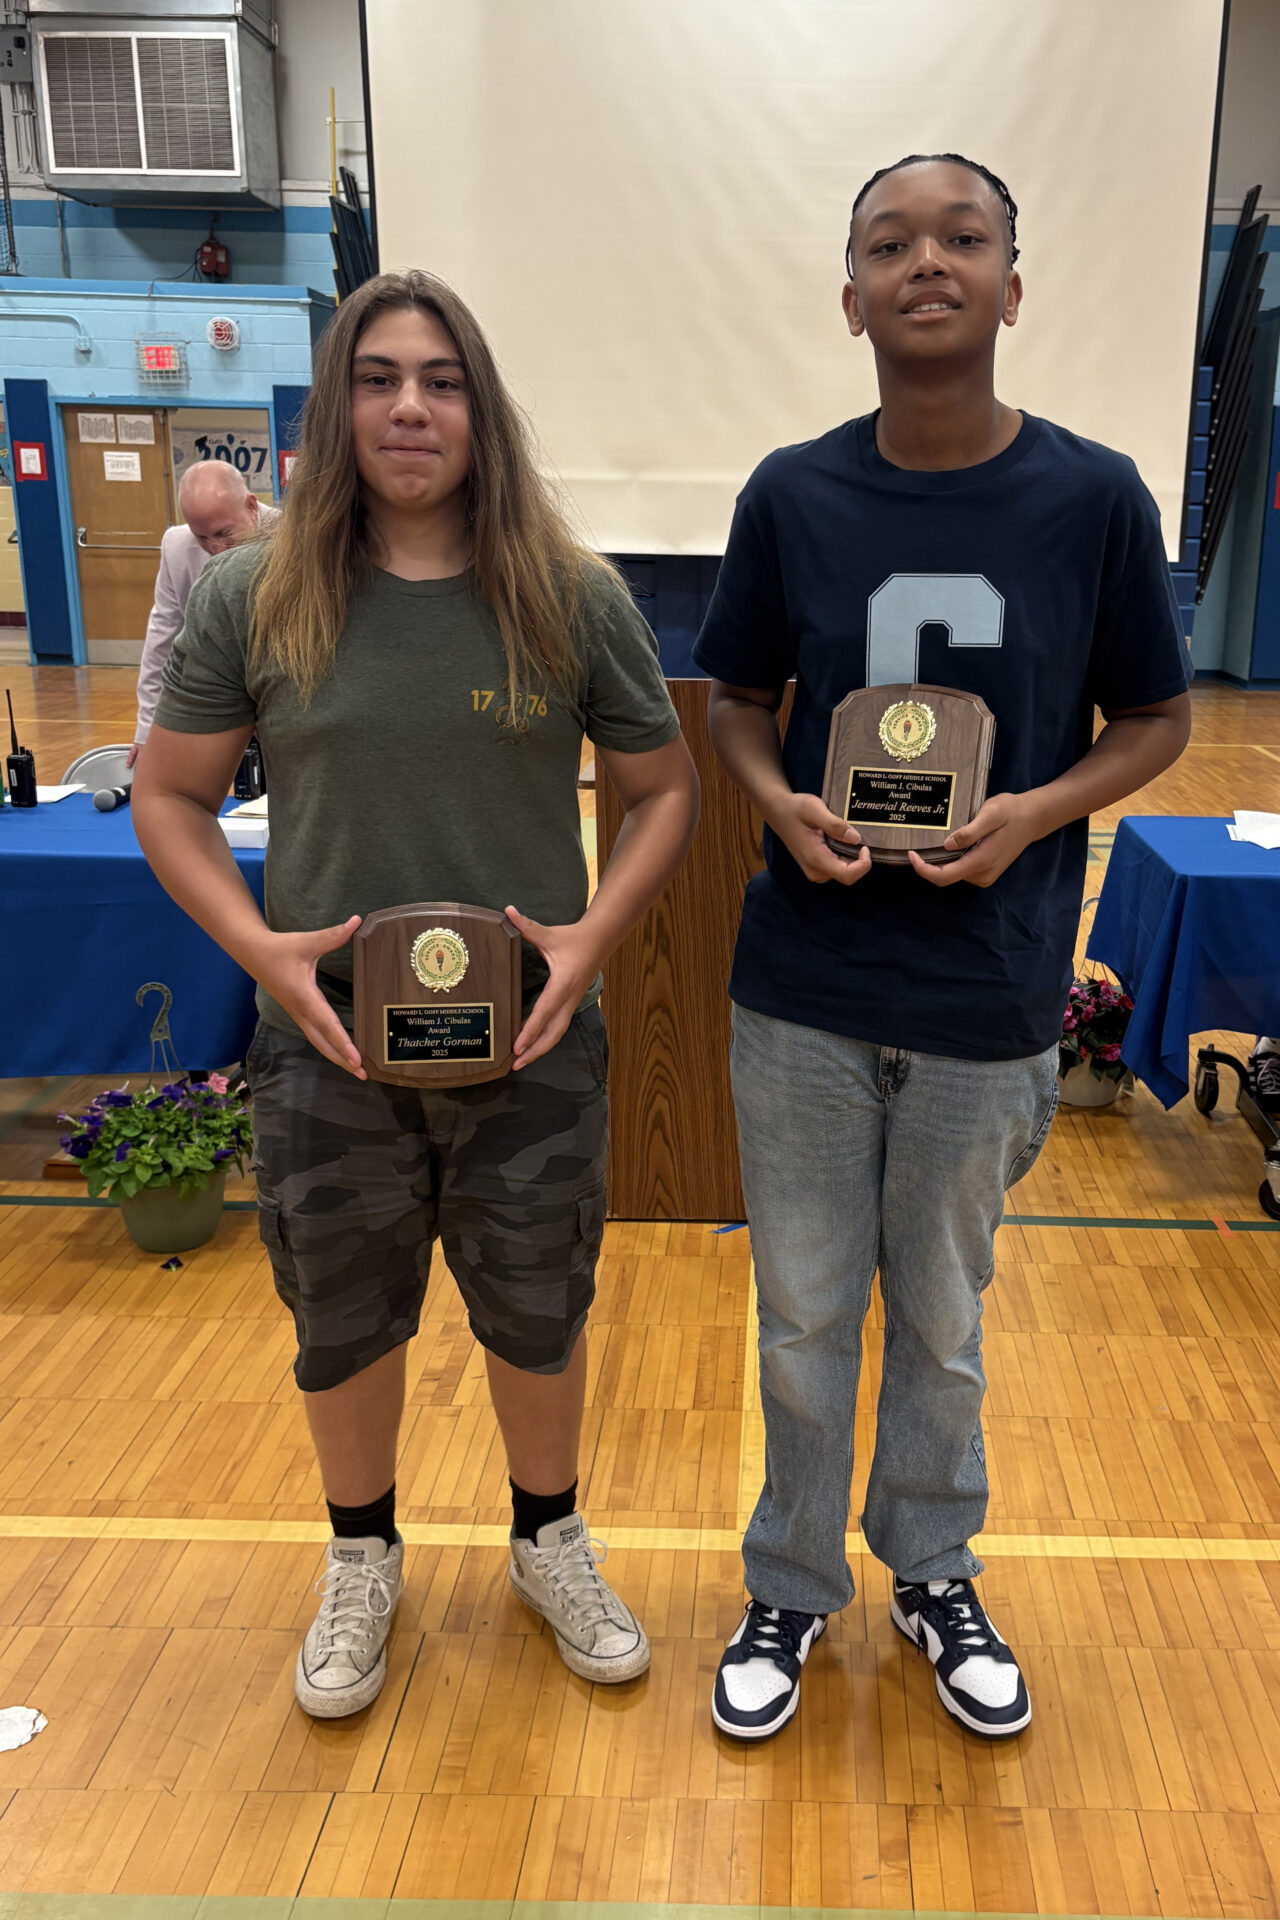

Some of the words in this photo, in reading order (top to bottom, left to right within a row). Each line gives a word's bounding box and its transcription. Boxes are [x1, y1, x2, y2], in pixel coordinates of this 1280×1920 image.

[144, 346, 173, 370] EXIT
[471, 690, 495, 712] 17
[527, 695, 548, 717] 76
[870, 781, 897, 789] William
[898, 782, 905, 790] J.
[906, 782, 932, 791] Cibulas
[888, 791, 911, 799] Award
[852, 800, 897, 812] Jermerial
[899, 802, 932, 813] Reeves
[933, 804, 945, 814] Jr.
[407, 1017, 435, 1026] William
[436, 1017, 443, 1025] J.
[444, 1016, 471, 1025] Cibulas
[427, 1026, 451, 1034] Award
[398, 1037, 440, 1048] Thatcher
[443, 1036, 482, 1047] Gorman
[431, 1048, 449, 1057] 2025
